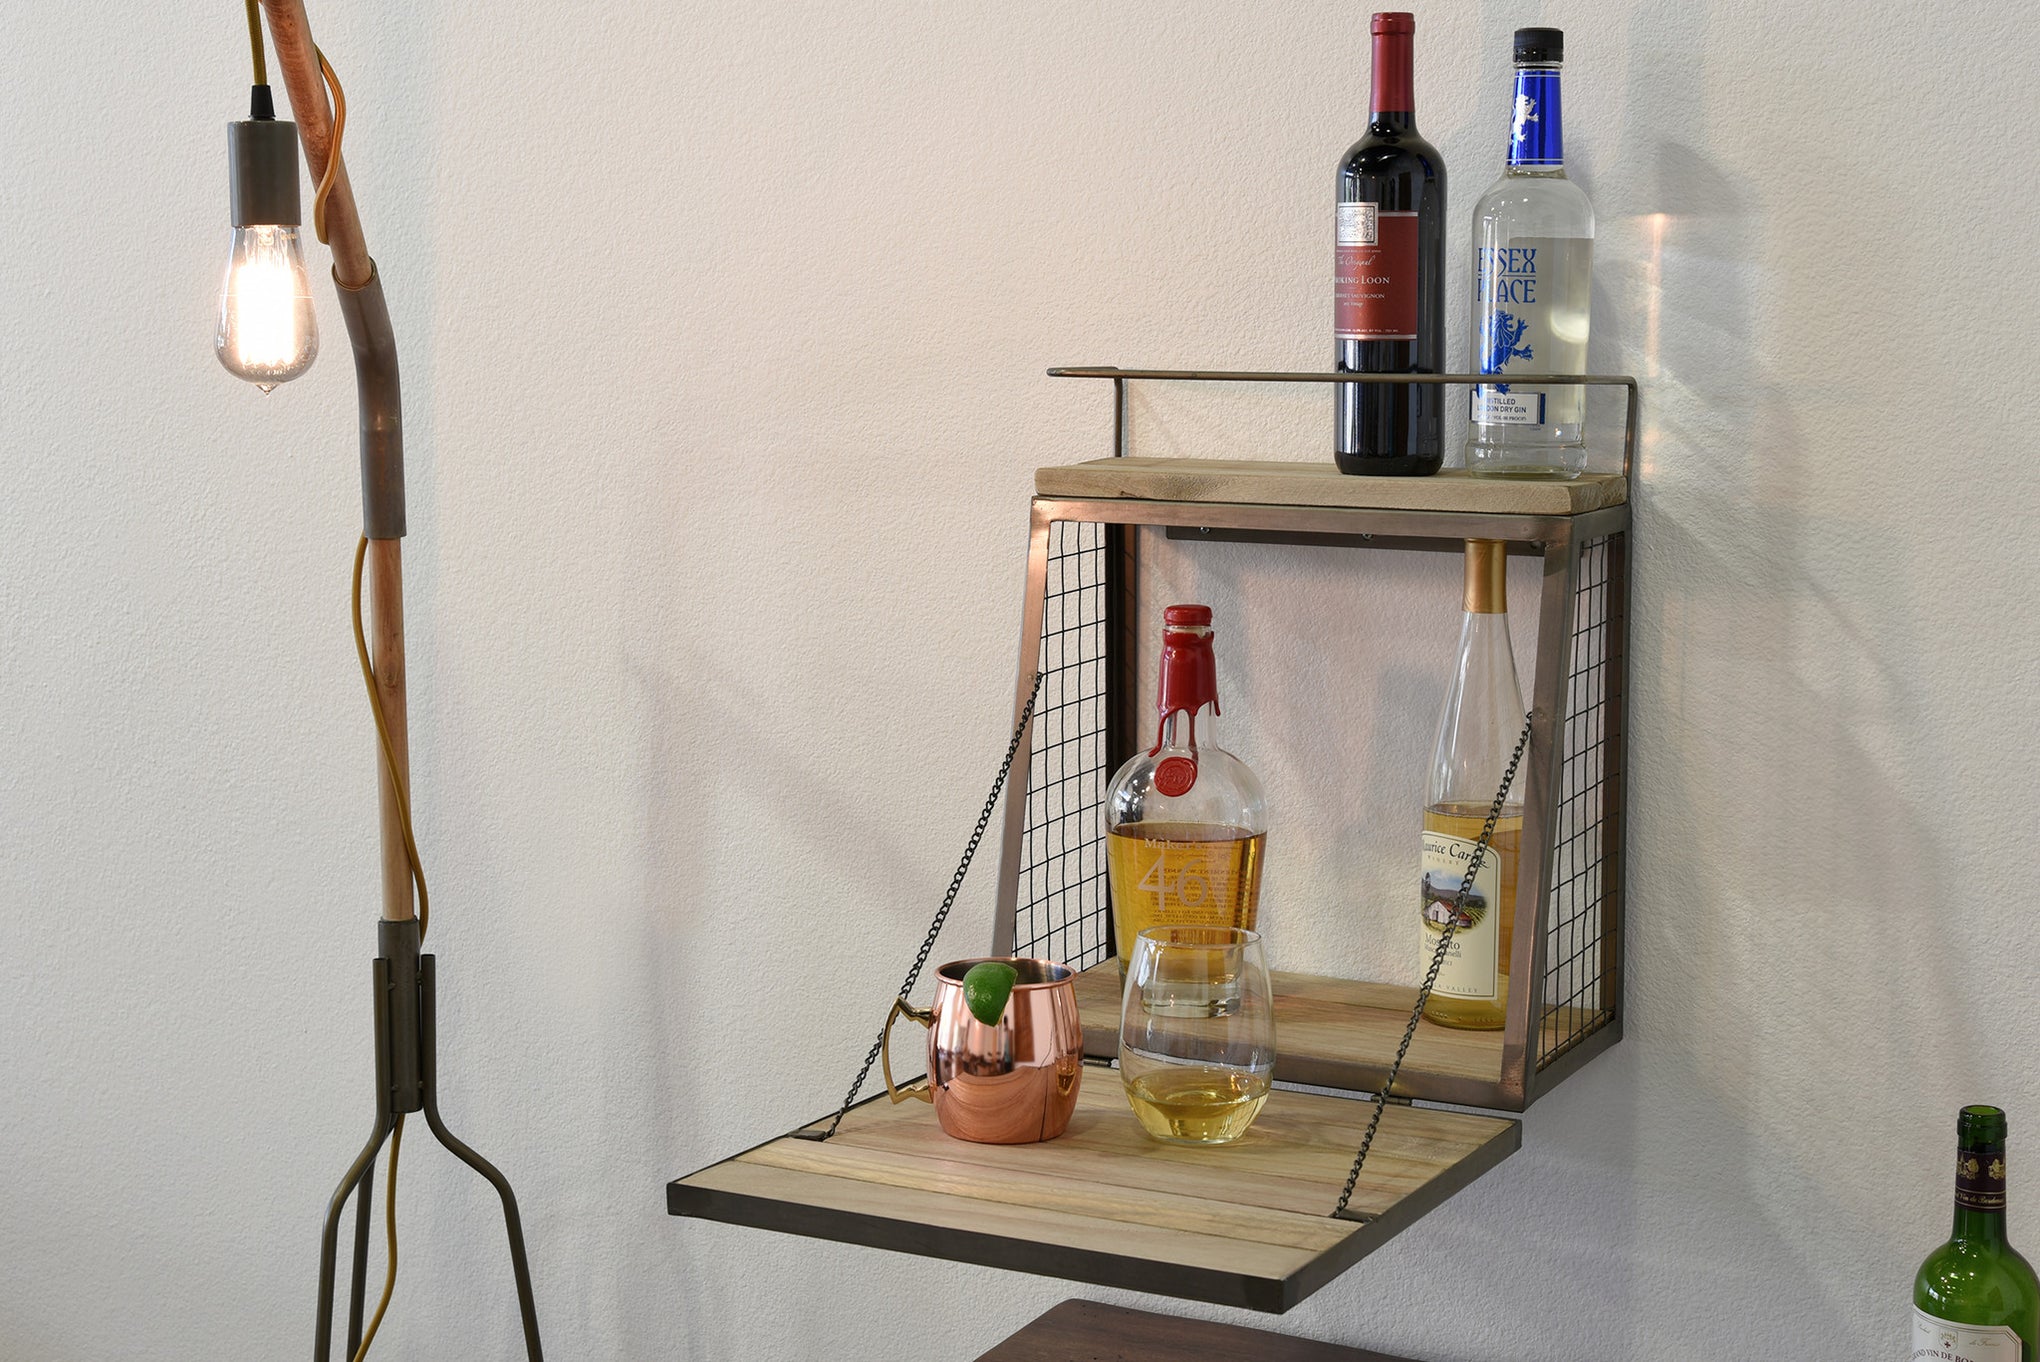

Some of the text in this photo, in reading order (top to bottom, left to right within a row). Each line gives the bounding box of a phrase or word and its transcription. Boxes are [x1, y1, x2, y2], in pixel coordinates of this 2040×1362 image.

[1477, 247, 1537, 278] ESSEX
[1514, 406, 1527, 414] GIN
[1138, 845, 1209, 911] 46
[1940, 1351, 1953, 1361] DE
